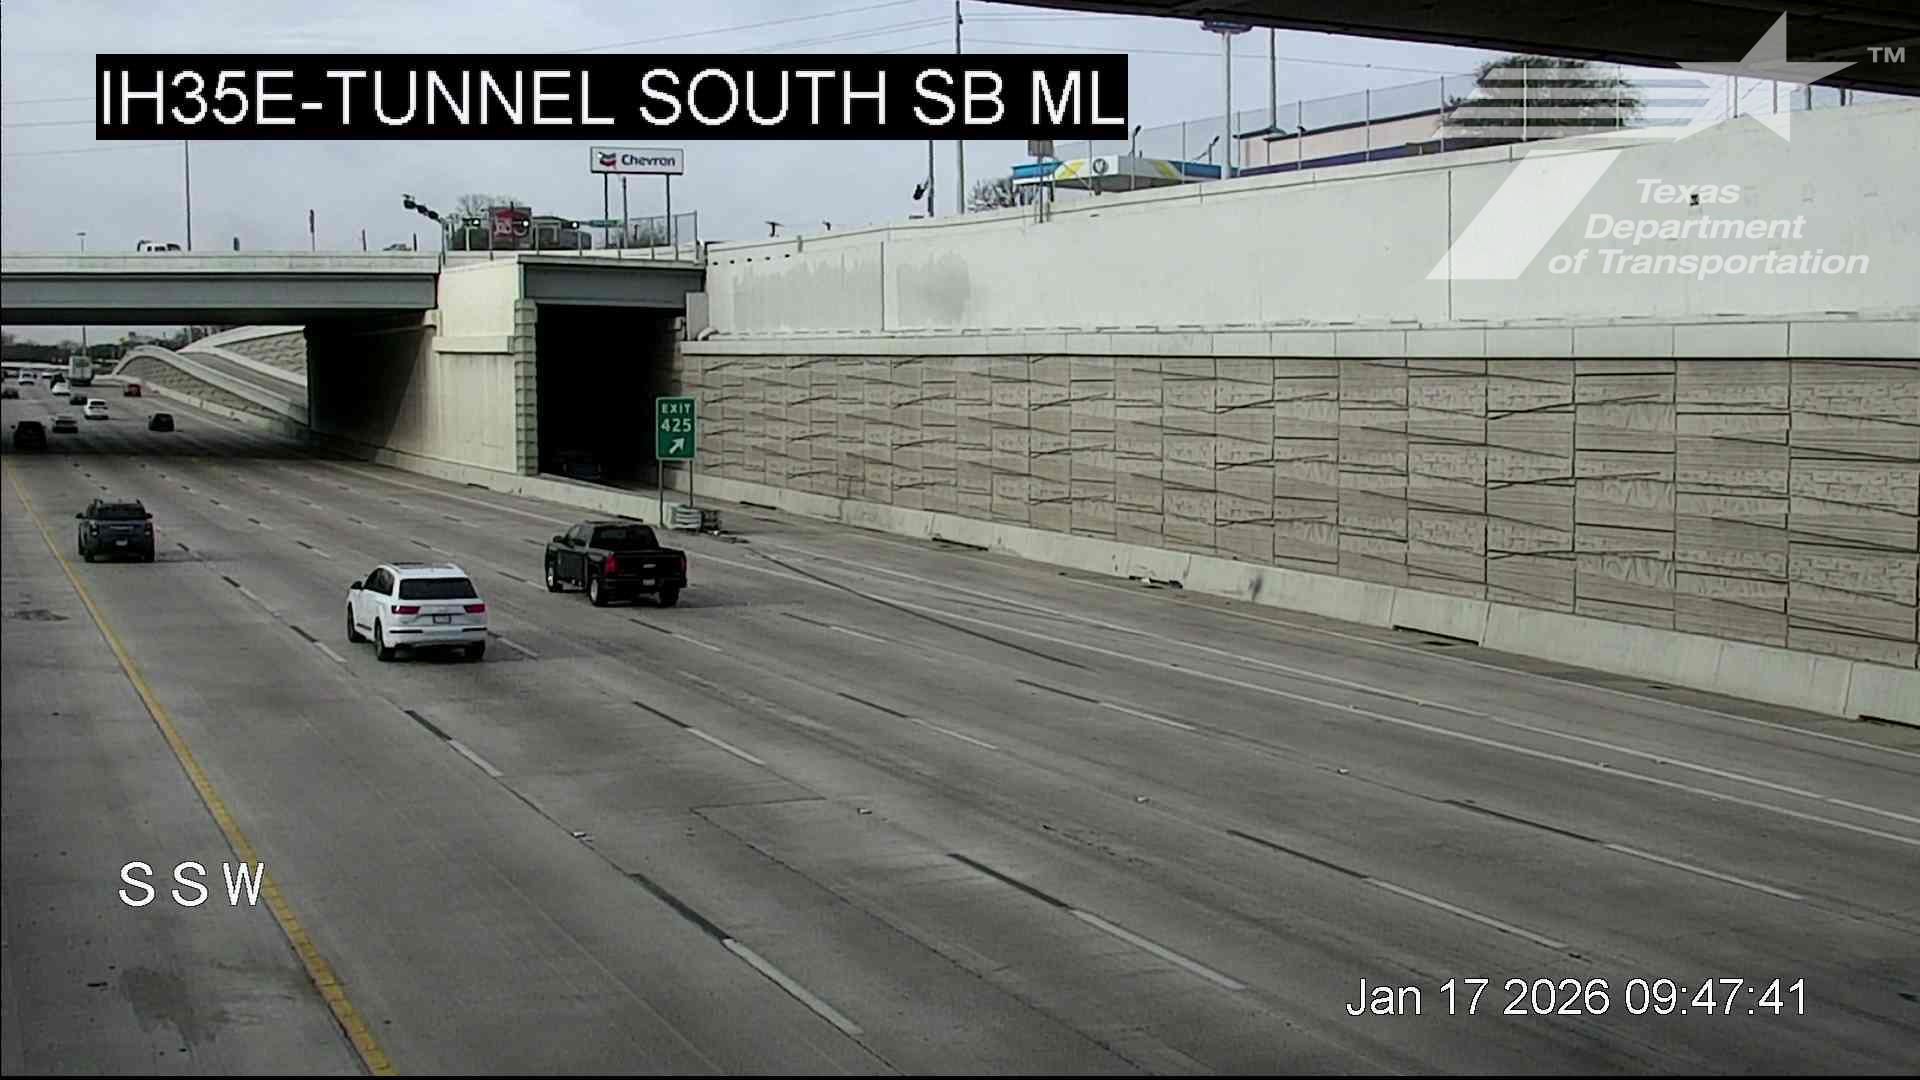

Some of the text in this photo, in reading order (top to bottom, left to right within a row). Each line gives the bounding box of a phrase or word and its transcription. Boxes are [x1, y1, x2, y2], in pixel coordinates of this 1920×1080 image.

[621, 153, 676, 167] Chevron
[661, 403, 692, 413] EXIT
[661, 418, 692, 432] 425
